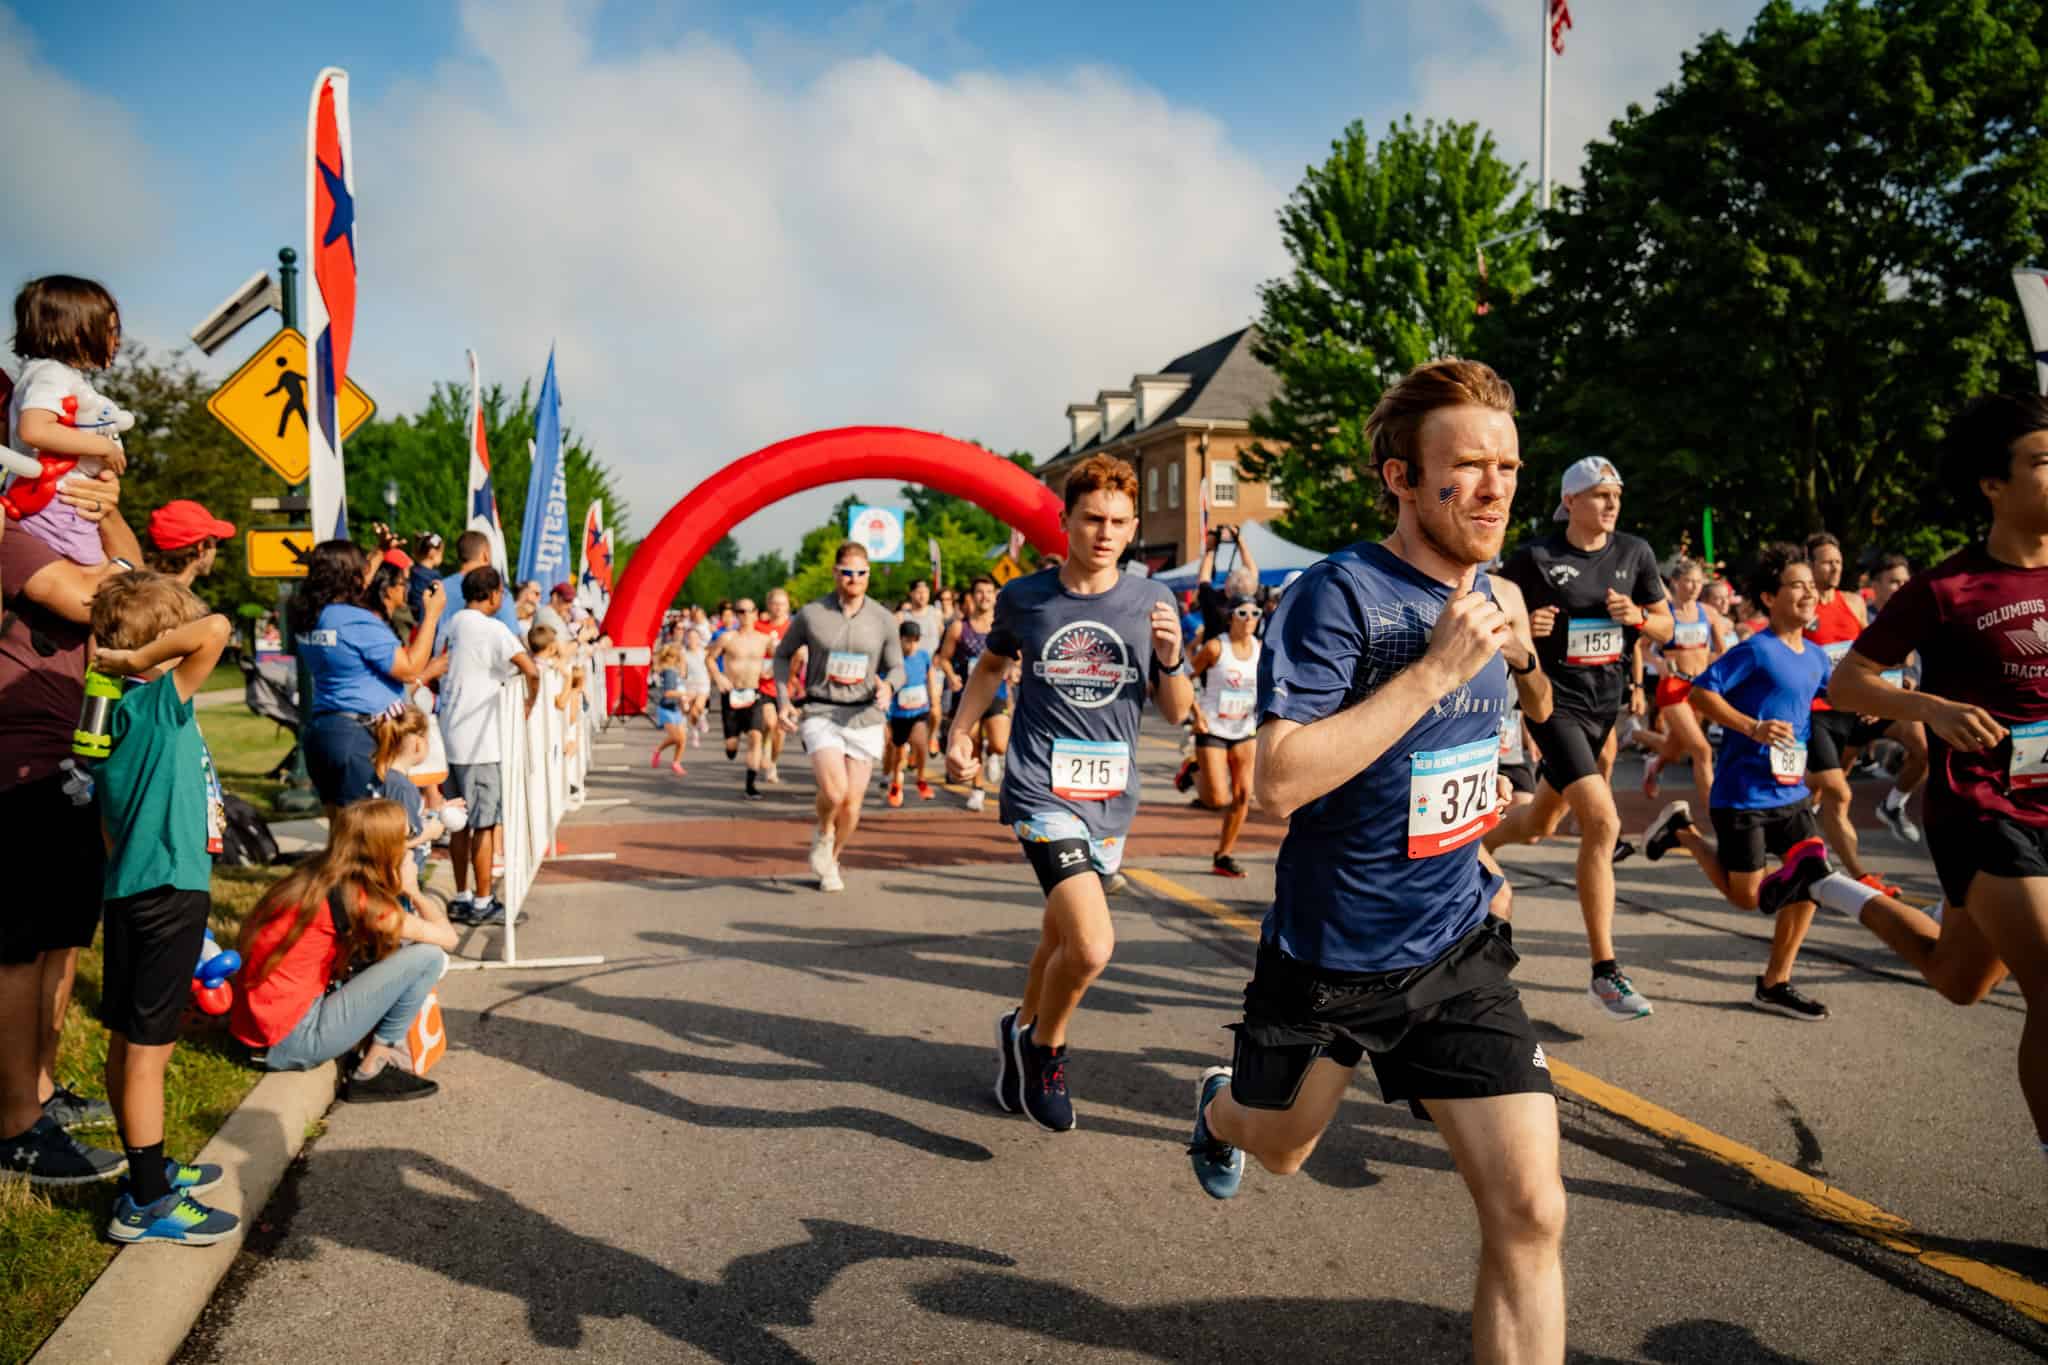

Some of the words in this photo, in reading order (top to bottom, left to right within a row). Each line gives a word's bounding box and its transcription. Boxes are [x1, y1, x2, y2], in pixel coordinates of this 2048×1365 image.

[1977, 599, 2046, 630] COLUMBUS
[1584, 632, 1611, 652] 153
[1075, 686, 1096, 701] 5K
[1071, 758, 1111, 785] 215
